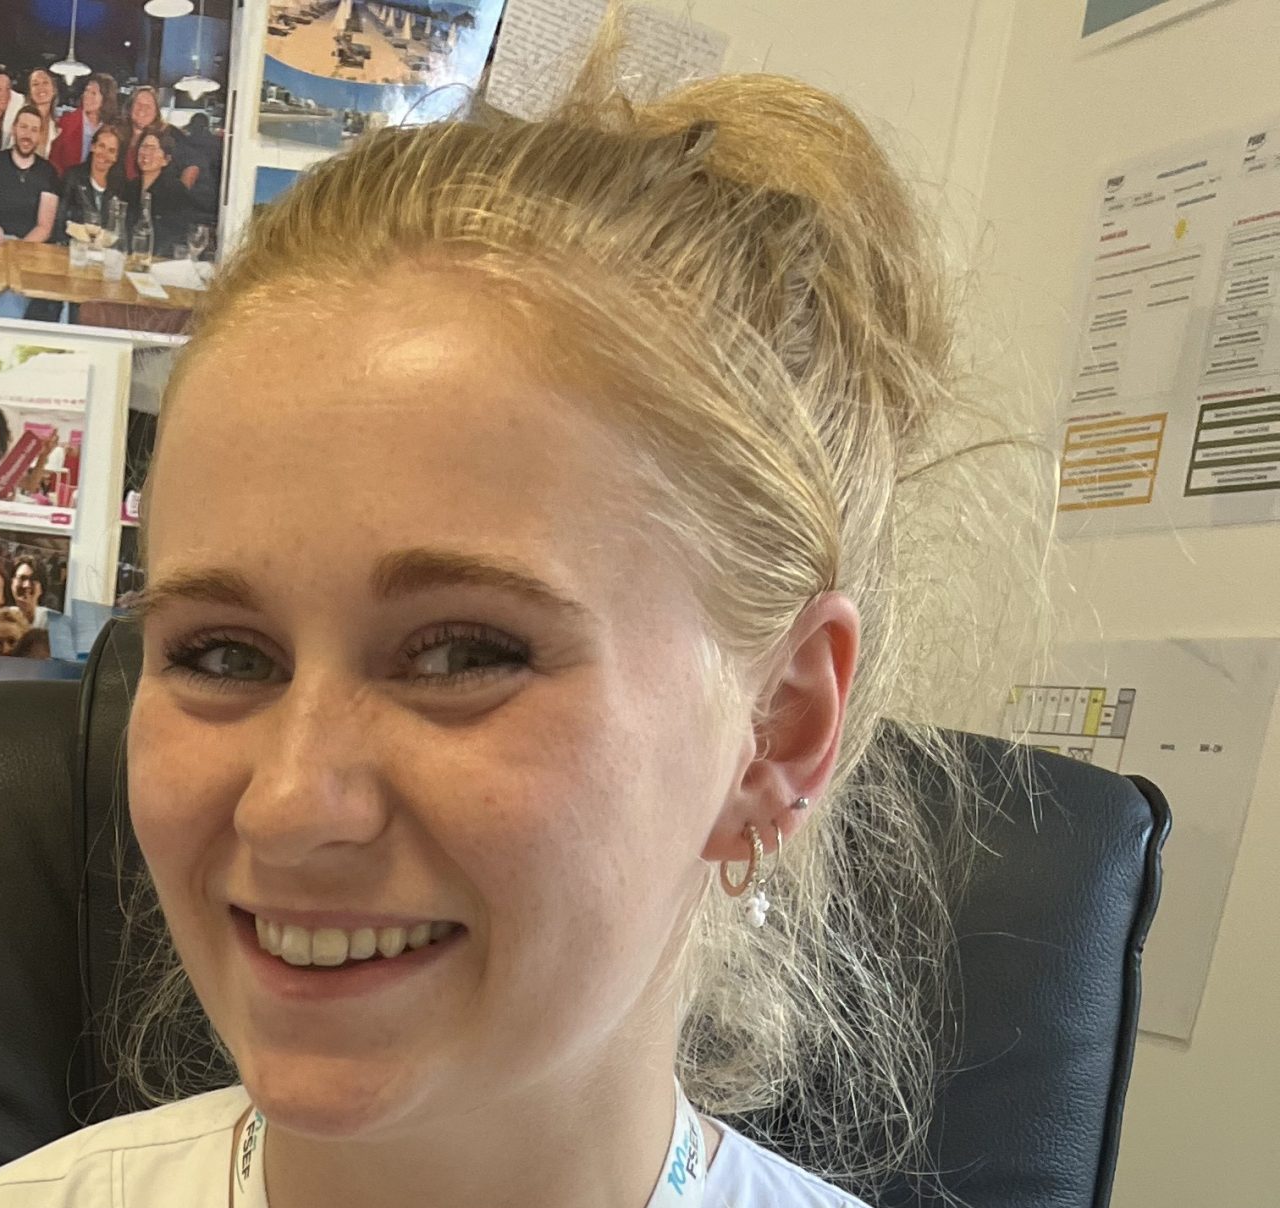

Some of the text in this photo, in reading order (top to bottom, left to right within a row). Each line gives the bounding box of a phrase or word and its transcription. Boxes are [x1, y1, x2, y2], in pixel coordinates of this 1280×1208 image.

[241, 1120, 256, 1181] FSEF
[667, 1145, 687, 1196] 100
[686, 1115, 699, 1181] FSEF
